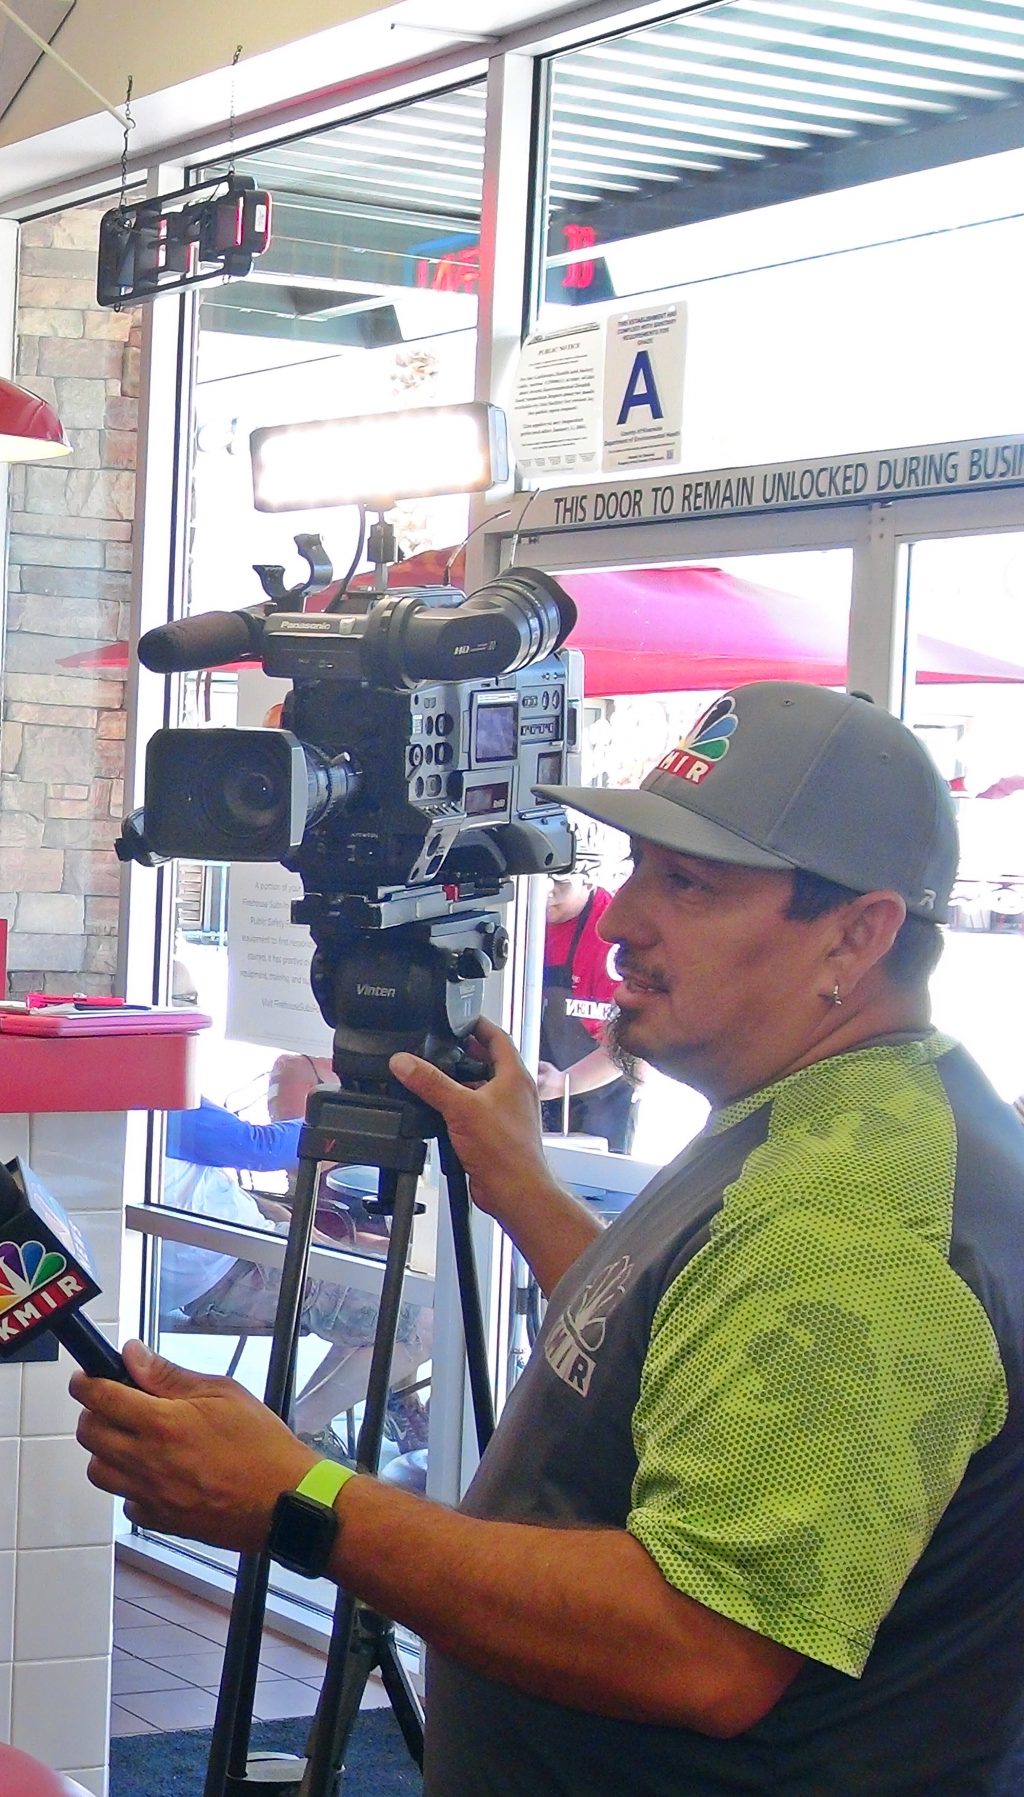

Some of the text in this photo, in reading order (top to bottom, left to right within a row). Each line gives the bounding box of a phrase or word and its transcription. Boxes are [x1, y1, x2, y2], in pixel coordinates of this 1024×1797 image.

[616, 350, 665, 425] A
[554, 496, 587, 525] THIS
[594, 489, 643, 521] DOOR
[651, 486, 675, 516] TO
[682, 476, 754, 513] REMAIN
[762, 463, 869, 504] UNLOCKED
[877, 451, 960, 491] DURING
[280, 620, 331, 631] Panasonic
[658, 750, 710, 783] MIR
